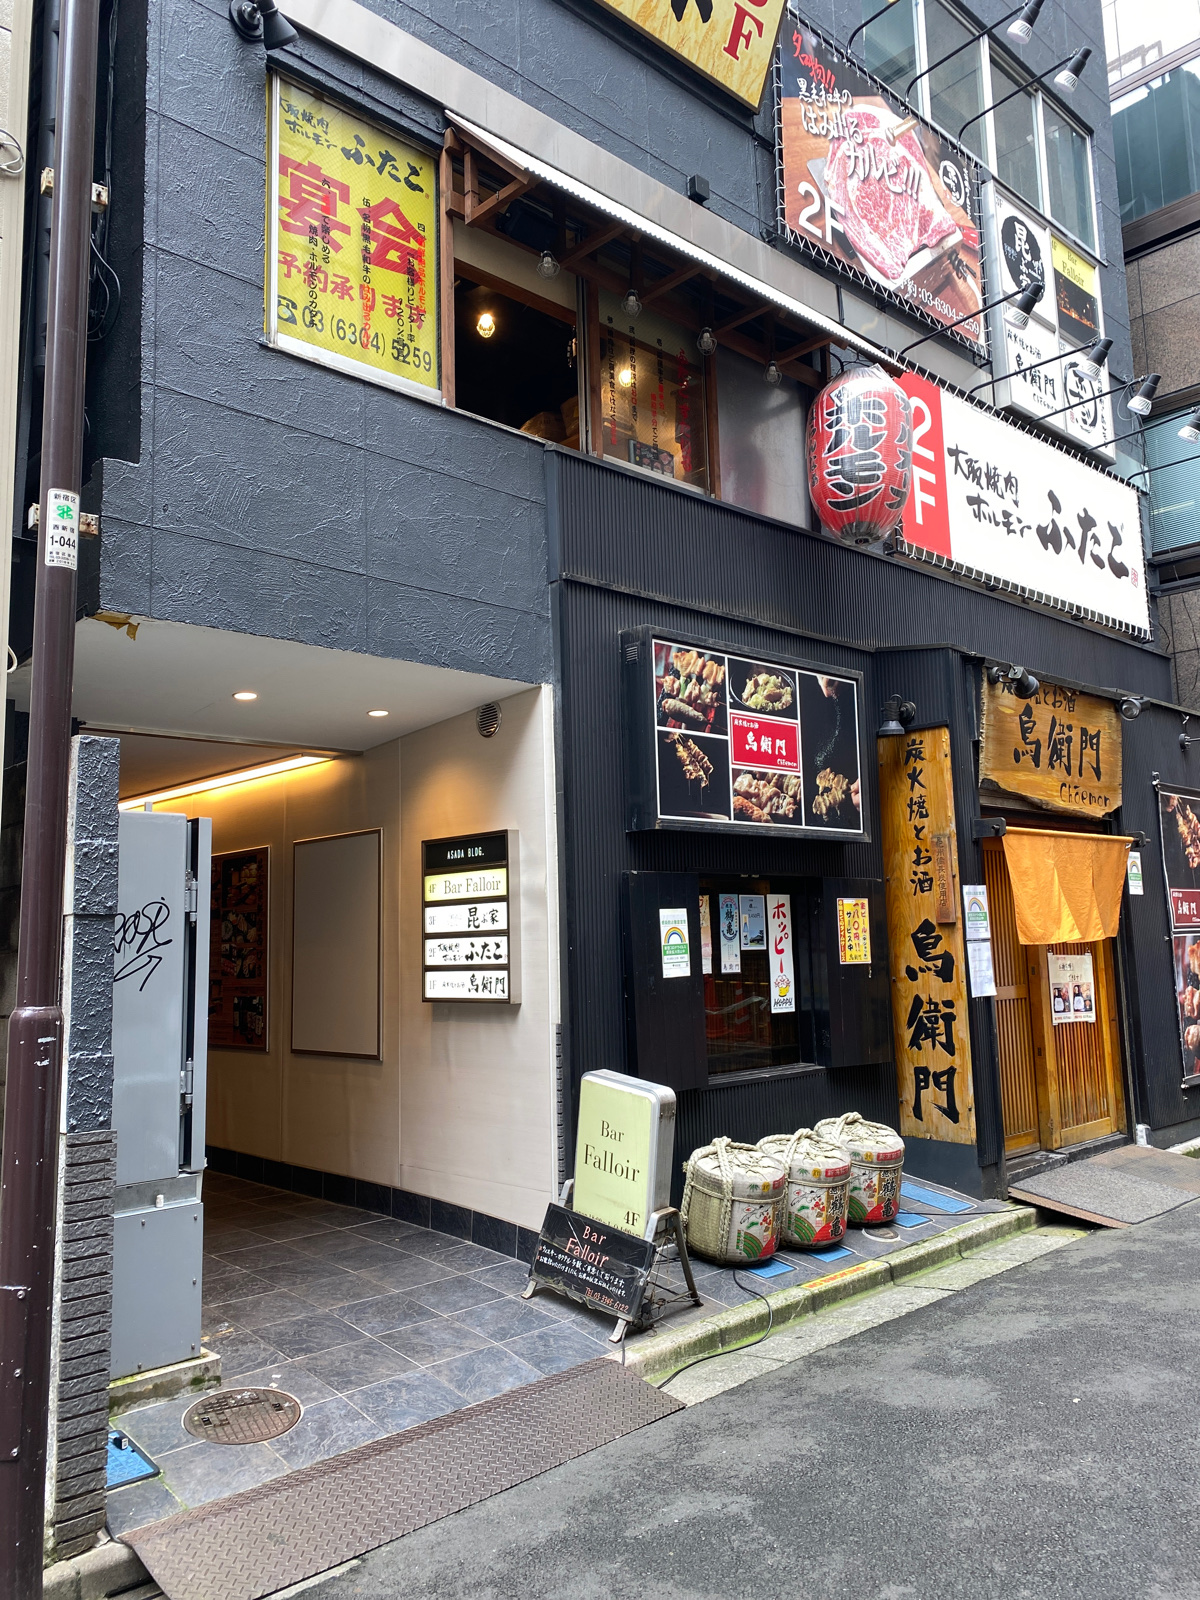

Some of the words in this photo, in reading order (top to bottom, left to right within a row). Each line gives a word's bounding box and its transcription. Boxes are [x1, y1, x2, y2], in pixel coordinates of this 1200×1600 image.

[796, 77, 853, 111] 黒毛和牛の
[284, 119, 337, 149] ホルモン
[800, 102, 863, 146] はみ出る
[341, 134, 424, 193] ふたご
[279, 153, 427, 286] 宴会
[797, 181, 845, 245] 2F
[1067, 251, 1078, 266] Bar
[1061, 261, 1084, 287] Falloir
[278, 250, 426, 330] 予約承ります
[909, 396, 937, 525] 2F
[947, 444, 1020, 508] 大阪焼肉
[54, 493, 76, 504] 新宿区
[52, 524, 75, 534] 西新宿
[966, 493, 1032, 538] ホルモン
[50, 535, 76, 550] 1-044
[1036, 490, 1130, 580] ふたご
[745, 731, 787, 756] 鳥衛門
[1013, 703, 1102, 782] 鳥衛門
[904, 738, 934, 896] 炭火焼とお酒
[447, 849, 464, 860] ASADA
[467, 847, 485, 857] BLDG.
[428, 883, 437, 894] 4F
[444, 880, 463, 894] Bar
[466, 876, 501, 892] Falloir
[429, 915, 437, 926] 3F
[468, 906, 499, 929] 昆ぶ家
[772, 898, 789, 974] ホッピー
[429, 947, 437, 958] 2F
[465, 940, 503, 961] ふたご
[429, 980, 436, 990] 1F
[468, 973, 505, 994] 鳥衛門
[905, 918, 960, 1124] 鳥衛門
[600, 1120, 625, 1142] Bar
[584, 1143, 640, 1183] Falloir
[623, 1210, 641, 1227] 4F
[582, 1225, 607, 1245] Bar
[565, 1237, 610, 1268] Falloir
